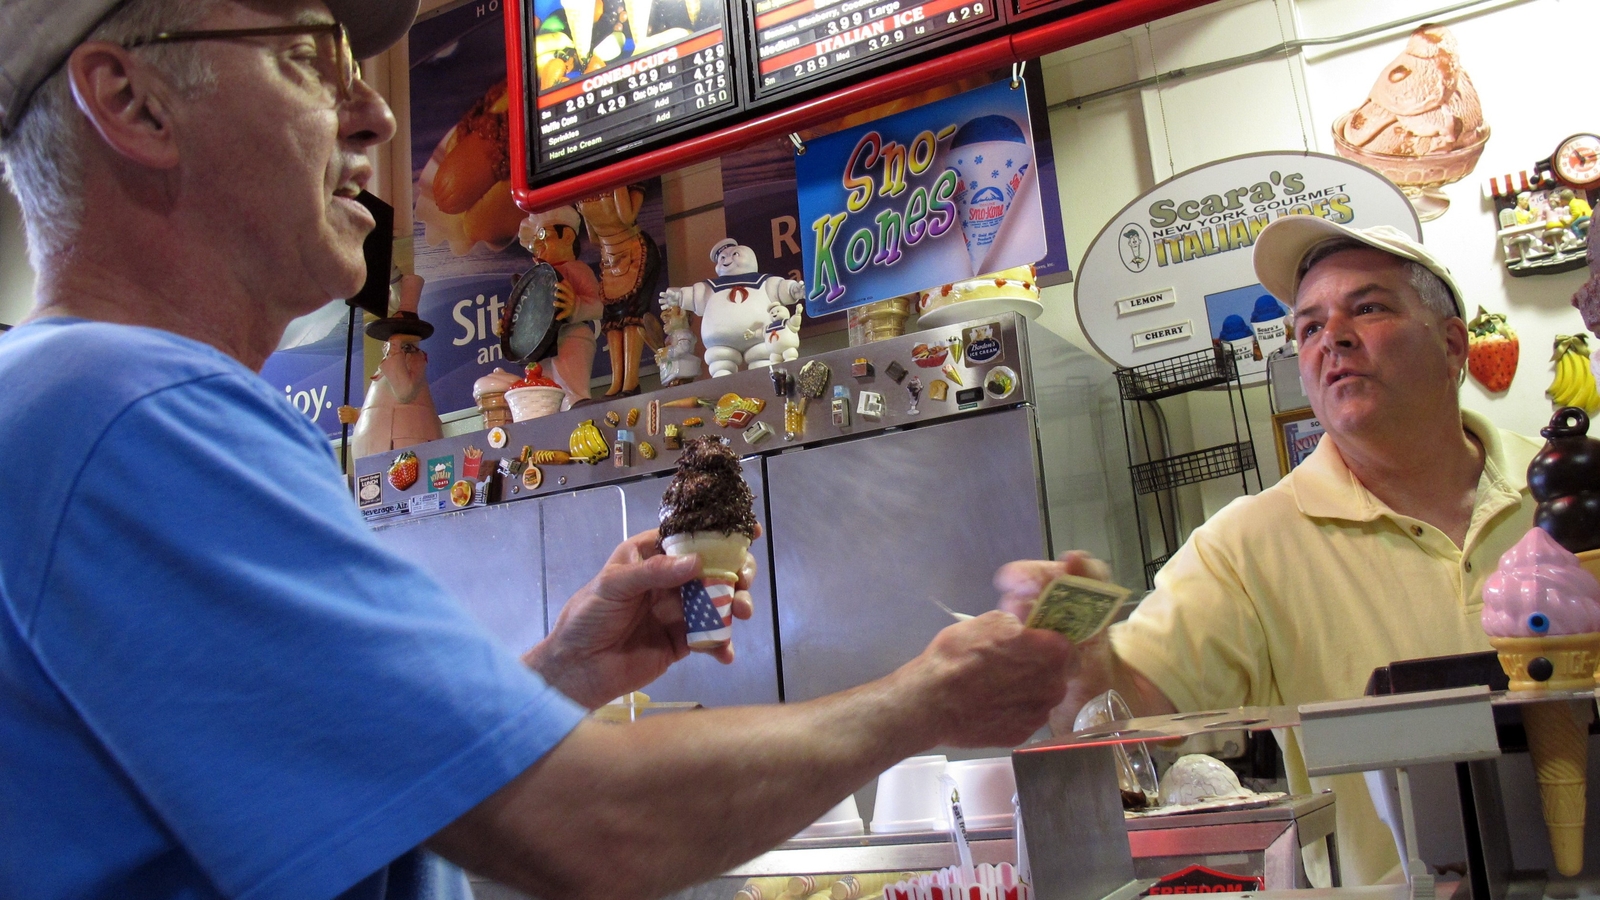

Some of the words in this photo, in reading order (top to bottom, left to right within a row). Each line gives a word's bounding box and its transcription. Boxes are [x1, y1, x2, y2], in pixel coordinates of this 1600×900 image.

[760, 37, 800, 58] Medium
[868, 1, 900, 19] Large
[815, 20, 885, 56] ITALIAN
[893, 6, 925, 29] ICE
[582, 47, 678, 92] CONES/CUPS
[764, 77, 776, 86] Sm
[914, 25, 925, 35] Lg
[548, 130, 580, 146] Sprinkles
[654, 96, 670, 109] Add
[549, 147, 565, 160] Hard
[566, 144, 578, 154] Ice
[579, 136, 603, 149] Cream
[655, 111, 671, 123] Add
[1149, 170, 1305, 228] Scara's
[1152, 222, 1192, 239] NEW
[1197, 208, 1248, 227] YORK
[1253, 183, 1347, 213] GOURMET
[808, 169, 957, 302] Kones
[1153, 212, 1270, 267] ITALIAN
[1130, 293, 1163, 308] LEMON
[979, 347, 998, 355] CREAM
[1145, 325, 1184, 341] CHERRY
